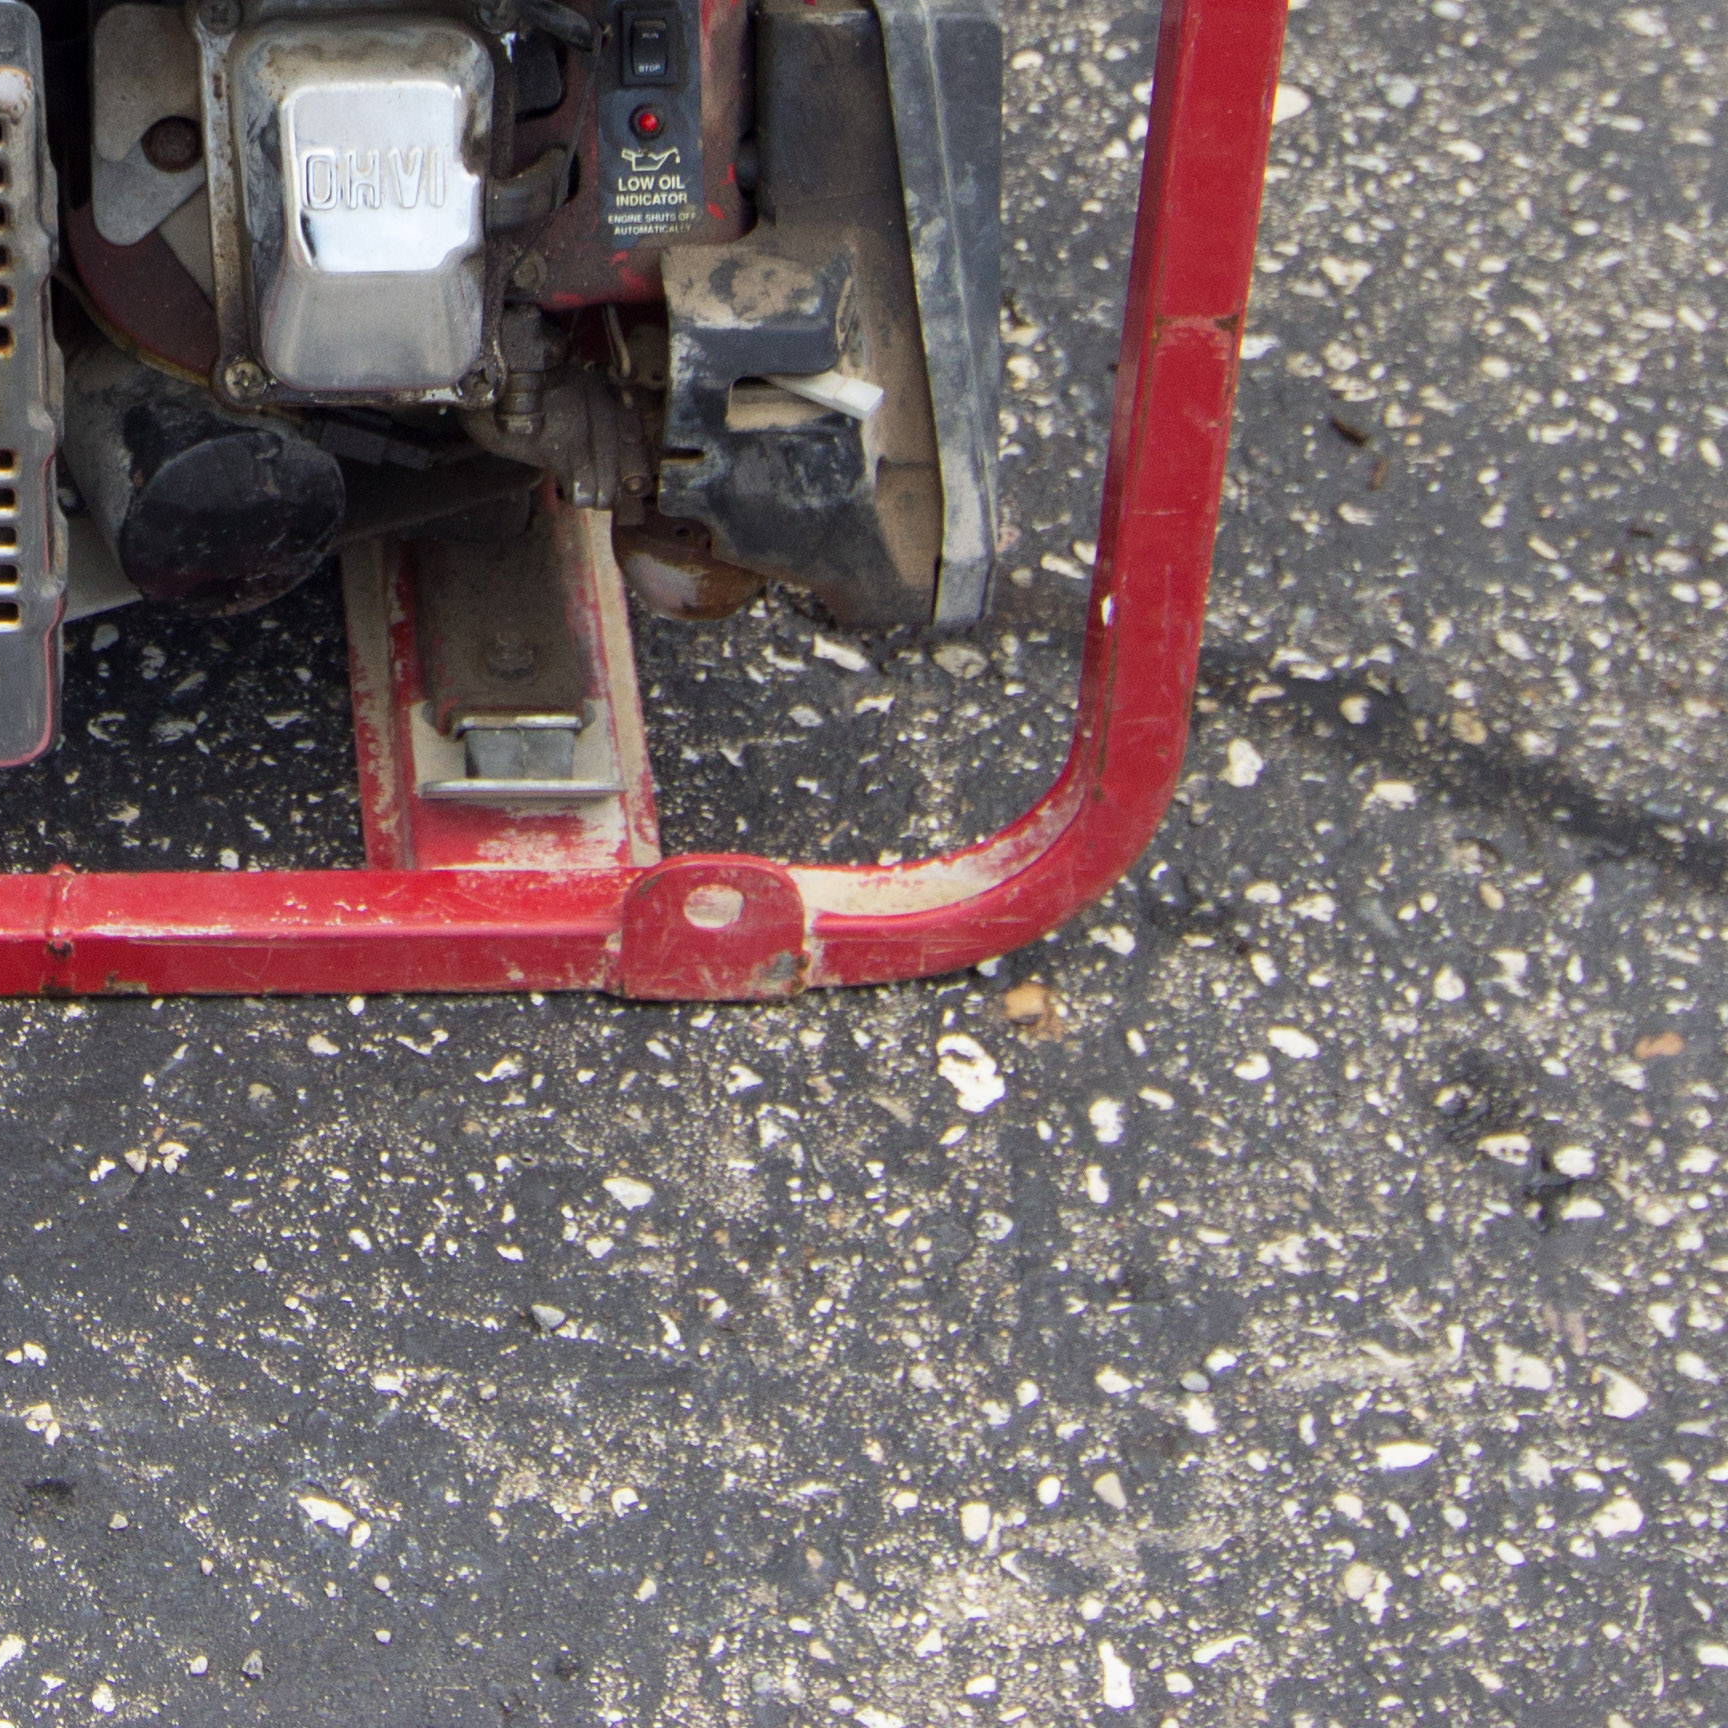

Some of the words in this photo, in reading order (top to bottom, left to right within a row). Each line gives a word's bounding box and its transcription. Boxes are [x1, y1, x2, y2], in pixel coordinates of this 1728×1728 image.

[638, 63, 661, 73] STOP
[302, 147, 446, 210] OHVI
[618, 176, 654, 191] LOW
[658, 174, 686, 190] OIL
[616, 191, 688, 207] INDICATOR
[607, 213, 643, 224] ENGINE
[645, 212, 676, 222] SHUTS
[678, 211, 697, 221] OFF
